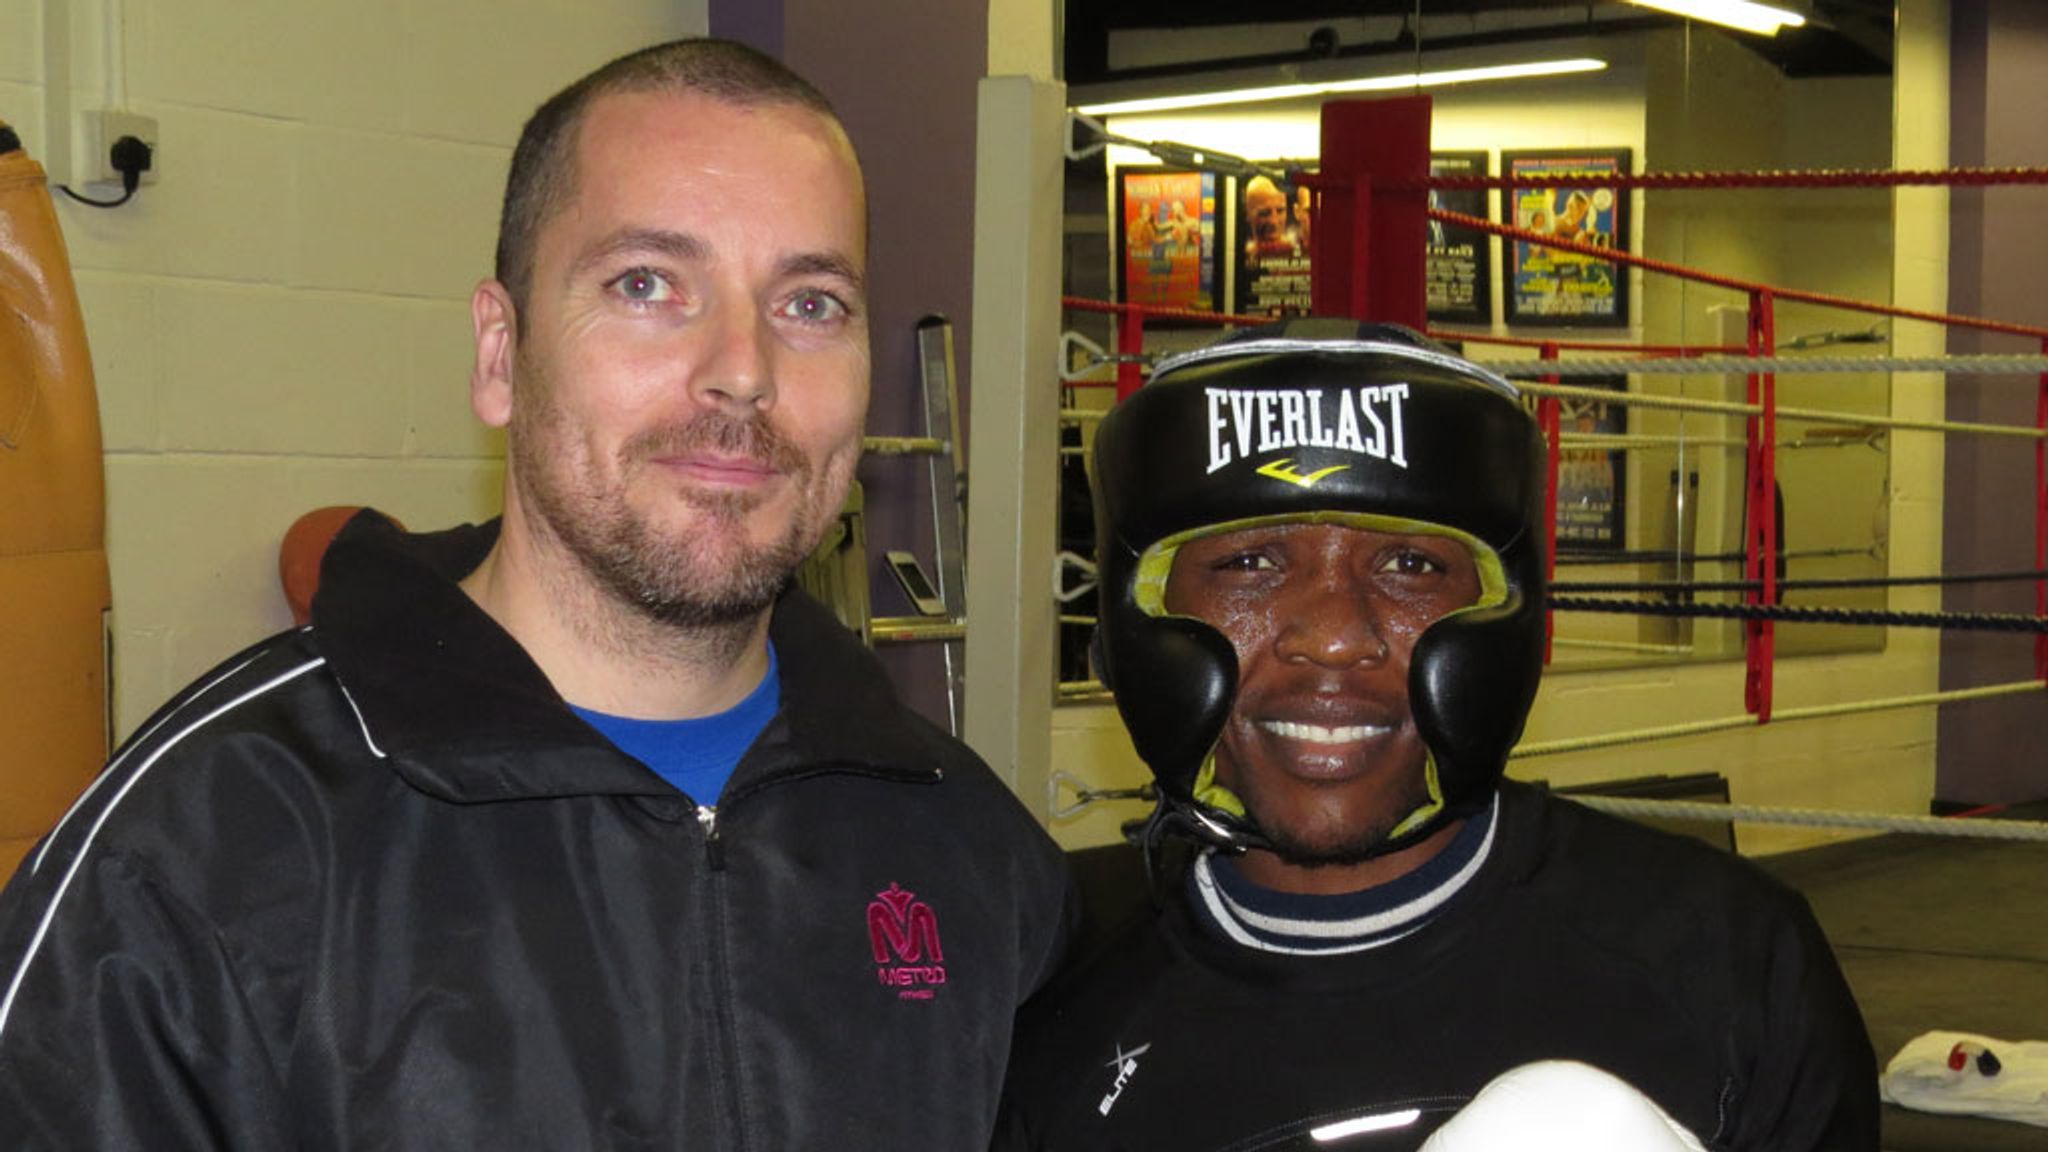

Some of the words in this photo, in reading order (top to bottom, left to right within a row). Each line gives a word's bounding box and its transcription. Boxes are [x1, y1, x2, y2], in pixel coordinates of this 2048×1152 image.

[1204, 382, 1410, 474] EVERLAST
[877, 965, 946, 986] METRO
[1098, 1058, 1138, 1116] ELITE
